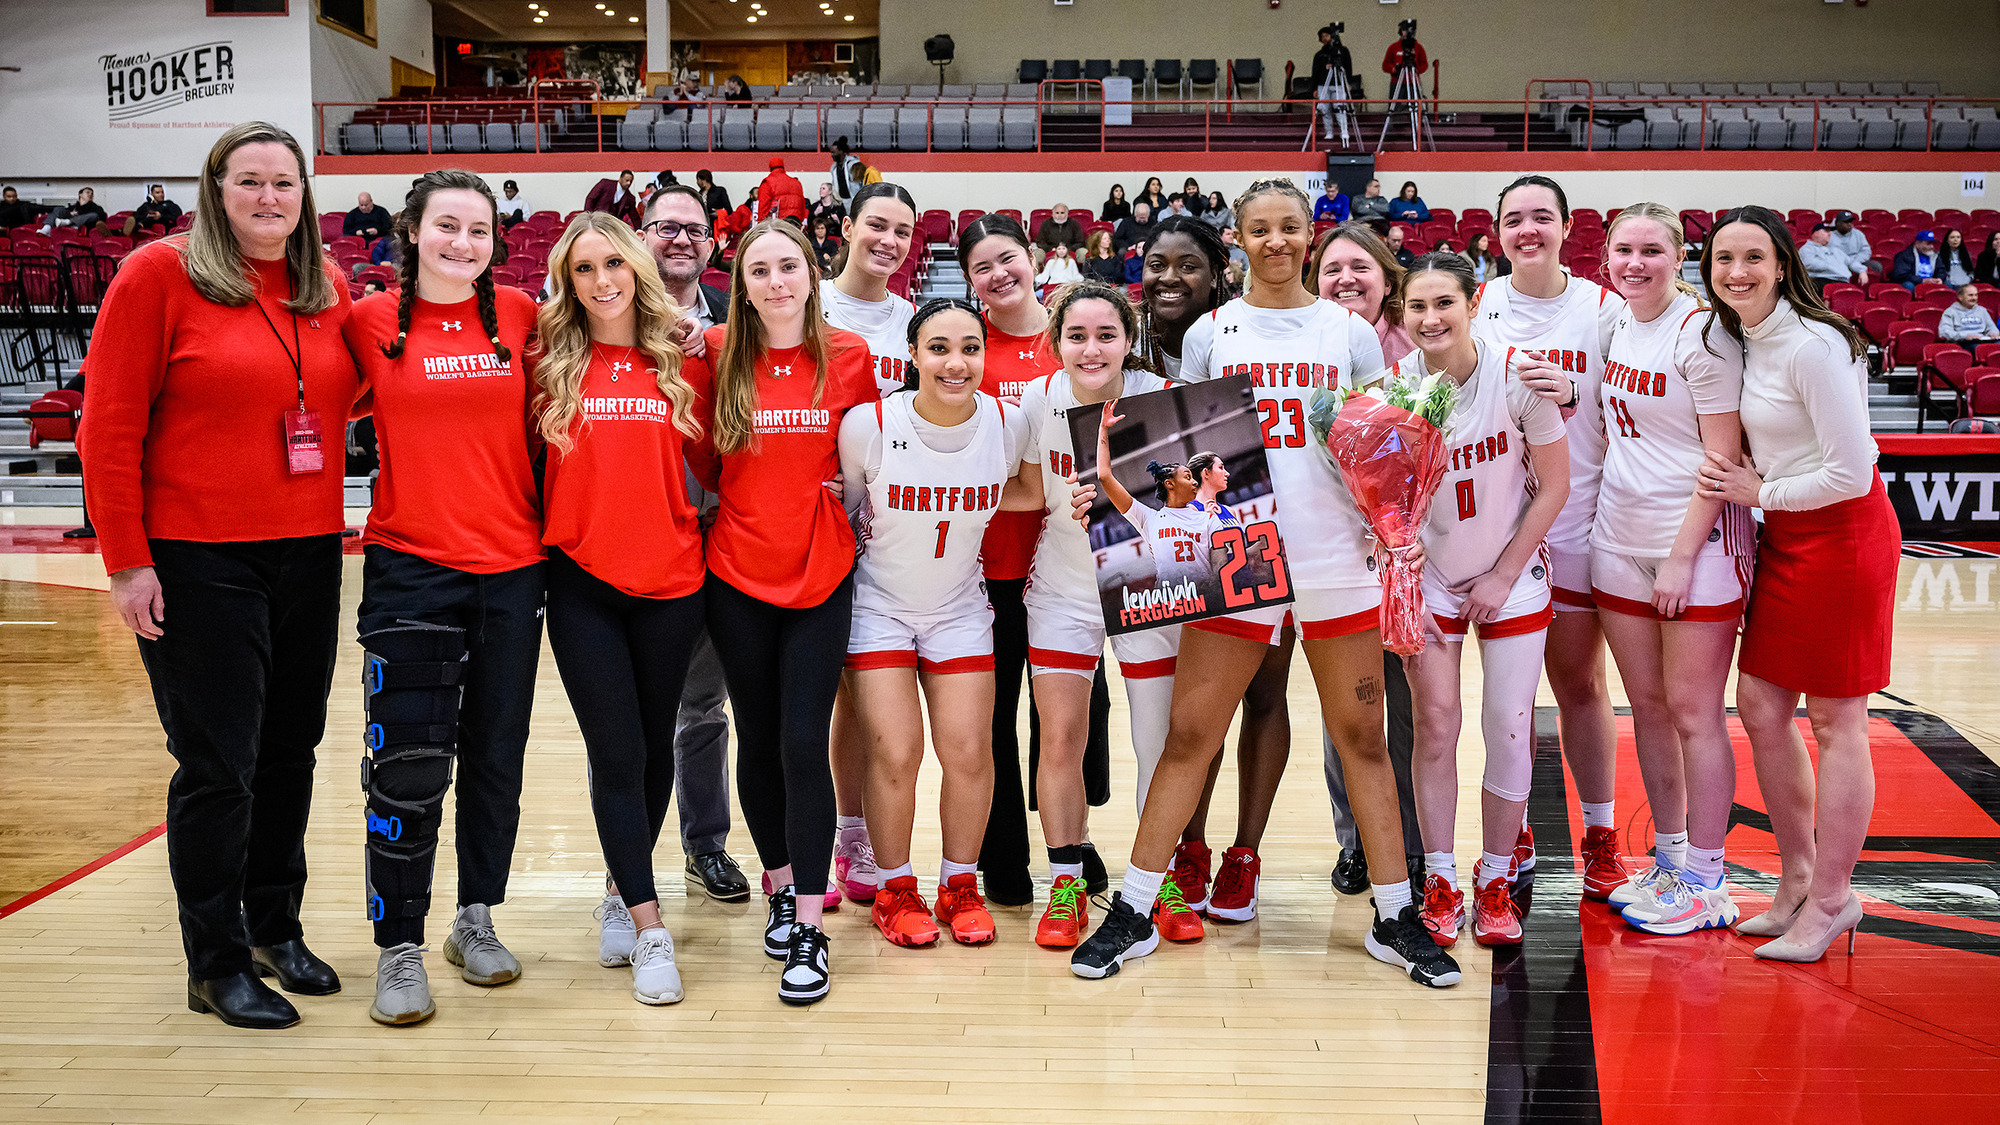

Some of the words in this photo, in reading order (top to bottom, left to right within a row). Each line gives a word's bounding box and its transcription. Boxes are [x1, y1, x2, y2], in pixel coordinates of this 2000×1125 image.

[98, 51, 151, 71] Thomas
[106, 45, 234, 106] HOOKER
[185, 83, 235, 102] BREWERY
[1964, 179, 1984, 190] 104
[426, 371, 465, 380] WOMEN'S
[466, 369, 512, 378] BASKETBALL
[584, 397, 667, 416] HARTFORD
[585, 413, 619, 421] WOMEN'S
[620, 413, 666, 423] BASKETBALL
[752, 409, 829, 427] HARTFORD
[1257, 398, 1306, 448] 23
[1610, 396, 1641, 438] 11
[288, 434, 322, 444] HARTFORD
[753, 426, 786, 434] WOMEN'S
[887, 483, 999, 512] HARTFORD
[1455, 478, 1476, 521] 0
[934, 521, 951, 559] 1
[1173, 541, 1196, 562] 23
[1211, 520, 1290, 608] 23
[1119, 594, 1207, 627] FERGUSON
